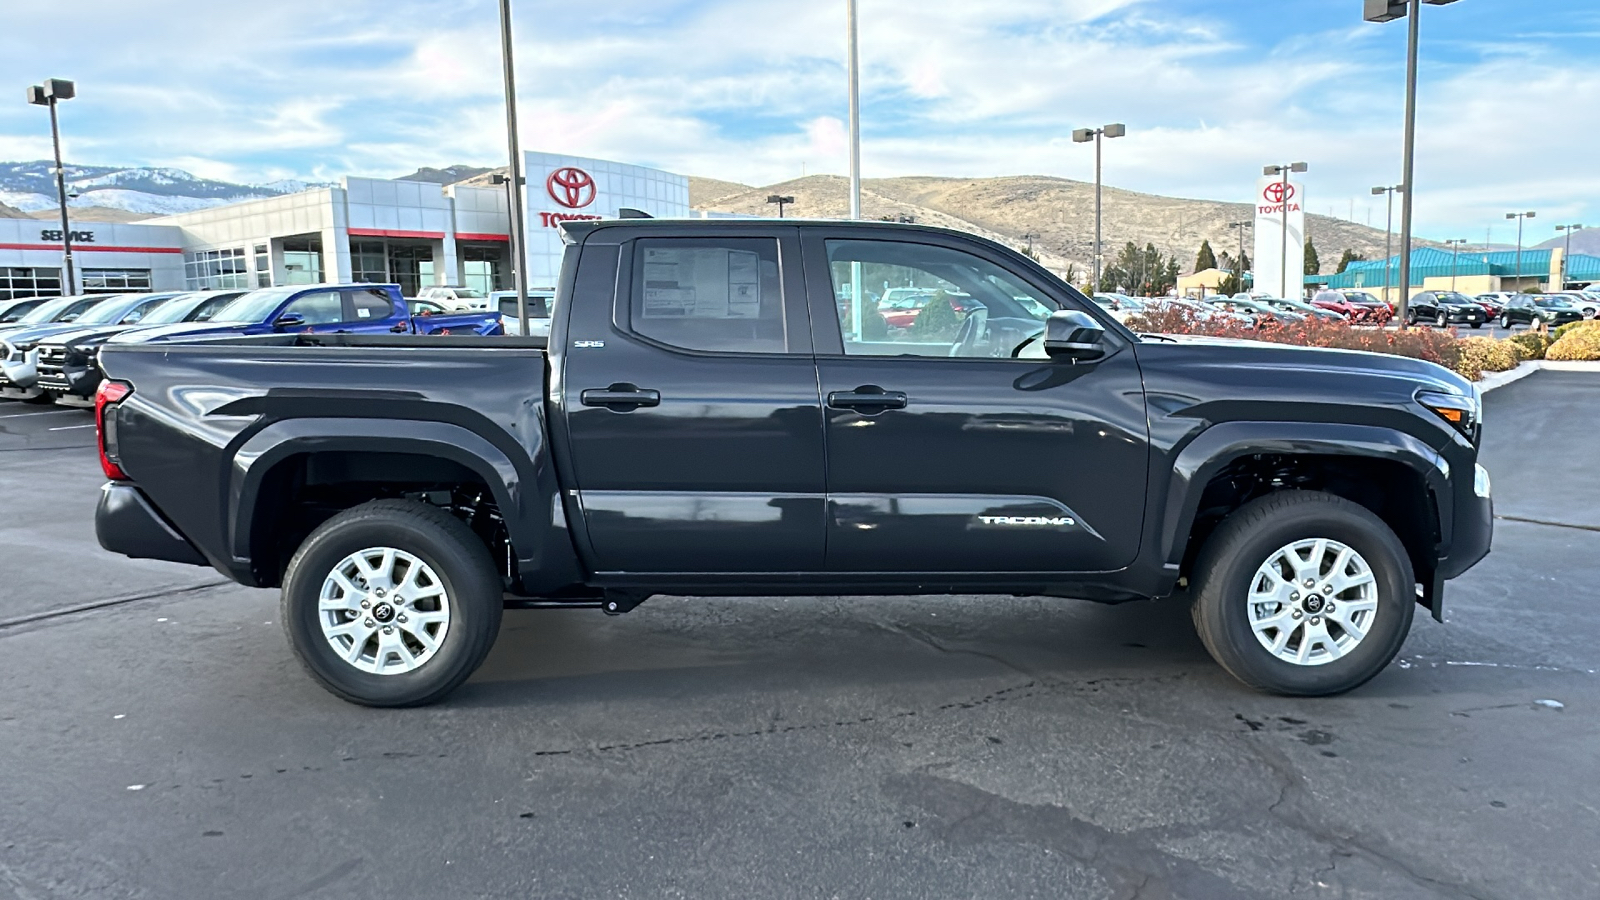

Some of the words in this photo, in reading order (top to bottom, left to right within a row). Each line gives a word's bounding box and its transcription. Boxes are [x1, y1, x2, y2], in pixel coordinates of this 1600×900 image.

[1258, 203, 1300, 214] TOYOTA
[538, 212, 602, 228] TOY
[574, 340, 605, 348] SR5
[978, 516, 1075, 525] TACOMA
